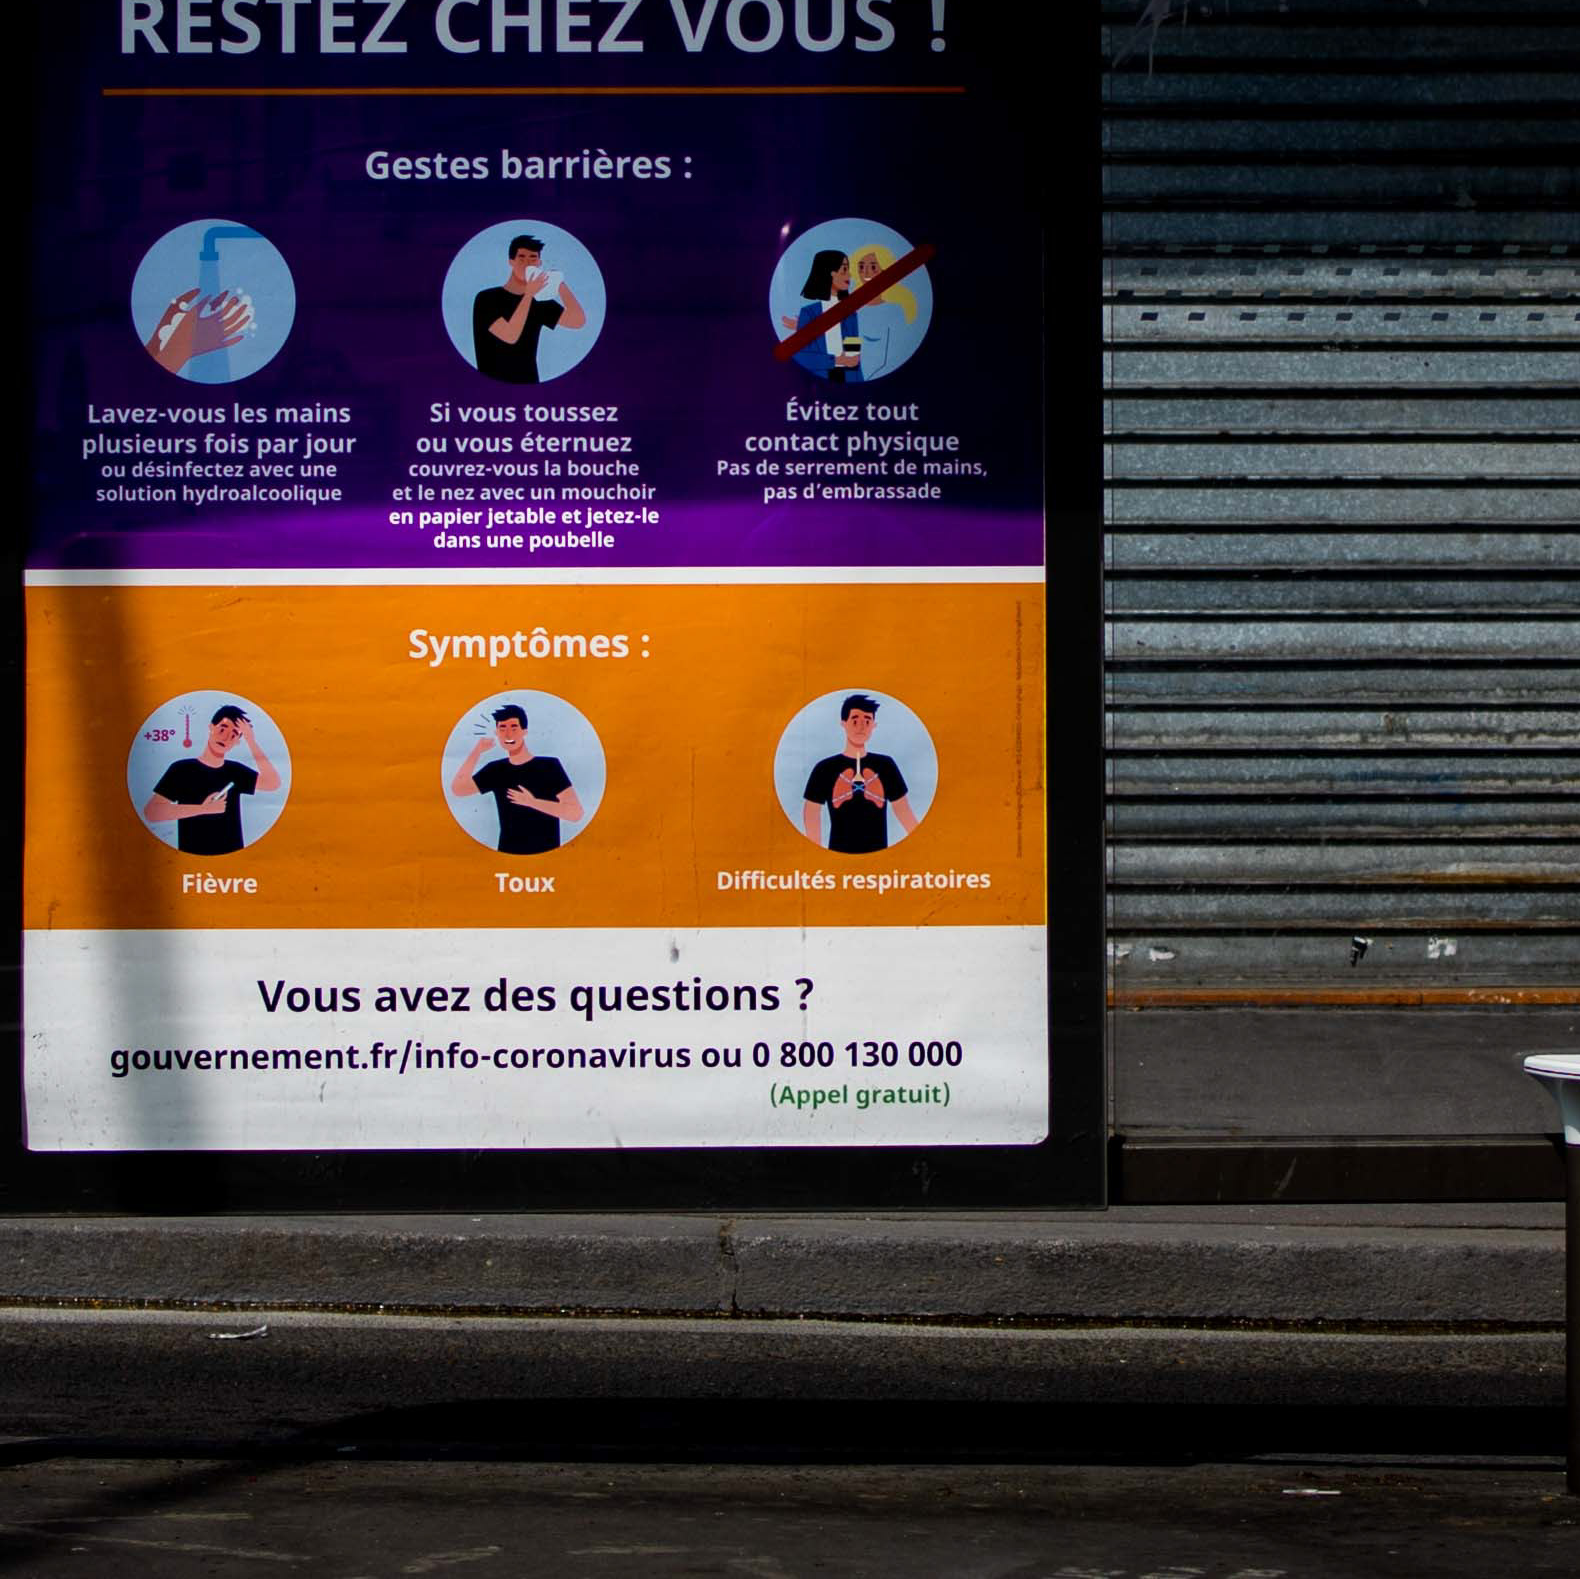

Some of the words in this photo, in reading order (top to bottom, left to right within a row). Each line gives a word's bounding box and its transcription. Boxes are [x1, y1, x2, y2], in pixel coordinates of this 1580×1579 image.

[365, 150, 489, 180] Gestes
[501, 148, 672, 180] barrières
[88, 404, 226, 424] Lavez-vous
[233, 402, 268, 424] les
[275, 402, 351, 424] mains
[429, 401, 450, 423] Si
[457, 406, 517, 423] vous
[523, 403, 619, 423] toussez
[786, 395, 859, 422] Évitez
[865, 403, 919, 421] tout
[82, 433, 197, 460] plusieurs
[203, 432, 249, 454] fois
[257, 437, 299, 460] par
[303, 432, 357, 460] jour
[416, 437, 447, 453] ou
[454, 436, 514, 453] vous
[520, 431, 633, 453] éternuez
[745, 433, 840, 452] contact
[847, 430, 959, 458] physique
[101, 465, 126, 478] ou
[131, 460, 244, 478] désinfectez
[249, 464, 295, 478] avec
[300, 464, 337, 478] une
[408, 463, 539, 477] couvrez-vous
[544, 459, 561, 477] la
[567, 459, 640, 477] bouche
[717, 459, 751, 476] Pas
[755, 458, 780, 476] de
[784, 460, 888, 476] serrement
[893, 458, 917, 475] de
[923, 462, 987, 477] mains,
[96, 485, 177, 502] solution
[182, 484, 342, 506] hydroalcoolique
[392, 486, 413, 501] et
[418, 484, 436, 501] le
[441, 487, 475, 501] nez
[479, 487, 525, 501] avec
[530, 487, 556, 501] un
[561, 483, 657, 501] mouchoir
[763, 486, 798, 505] pas
[388, 511, 414, 525] en
[419, 507, 484, 530] papier
[485, 507, 557, 529] jetable
[561, 508, 582, 525] et
[584, 506, 660, 529] jetez-le
[433, 531, 481, 549] dans
[486, 534, 524, 549] une
[529, 530, 615, 553] poubelle
[409, 627, 629, 668] Symptômes
[182, 872, 258, 894] Fièvre
[494, 872, 555, 893] Toux
[717, 869, 837, 891] Difficultés
[842, 869, 991, 895] respiratoires
[256, 979, 361, 1013] Vous
[374, 986, 471, 1013] avez
[483, 977, 557, 1012] des
[569, 976, 780, 1022] questions
[110, 1039, 691, 1078] gouvernement.fr/info-coronavirus
[701, 1047, 742, 1068] ou
[752, 1041, 770, 1068] 0
[779, 1041, 835, 1068] 800
[844, 1041, 899, 1068] 130
[908, 1040, 963, 1067] 000
[770, 1082, 848, 1110] (Appel
[855, 1082, 950, 1110] gratuit)
